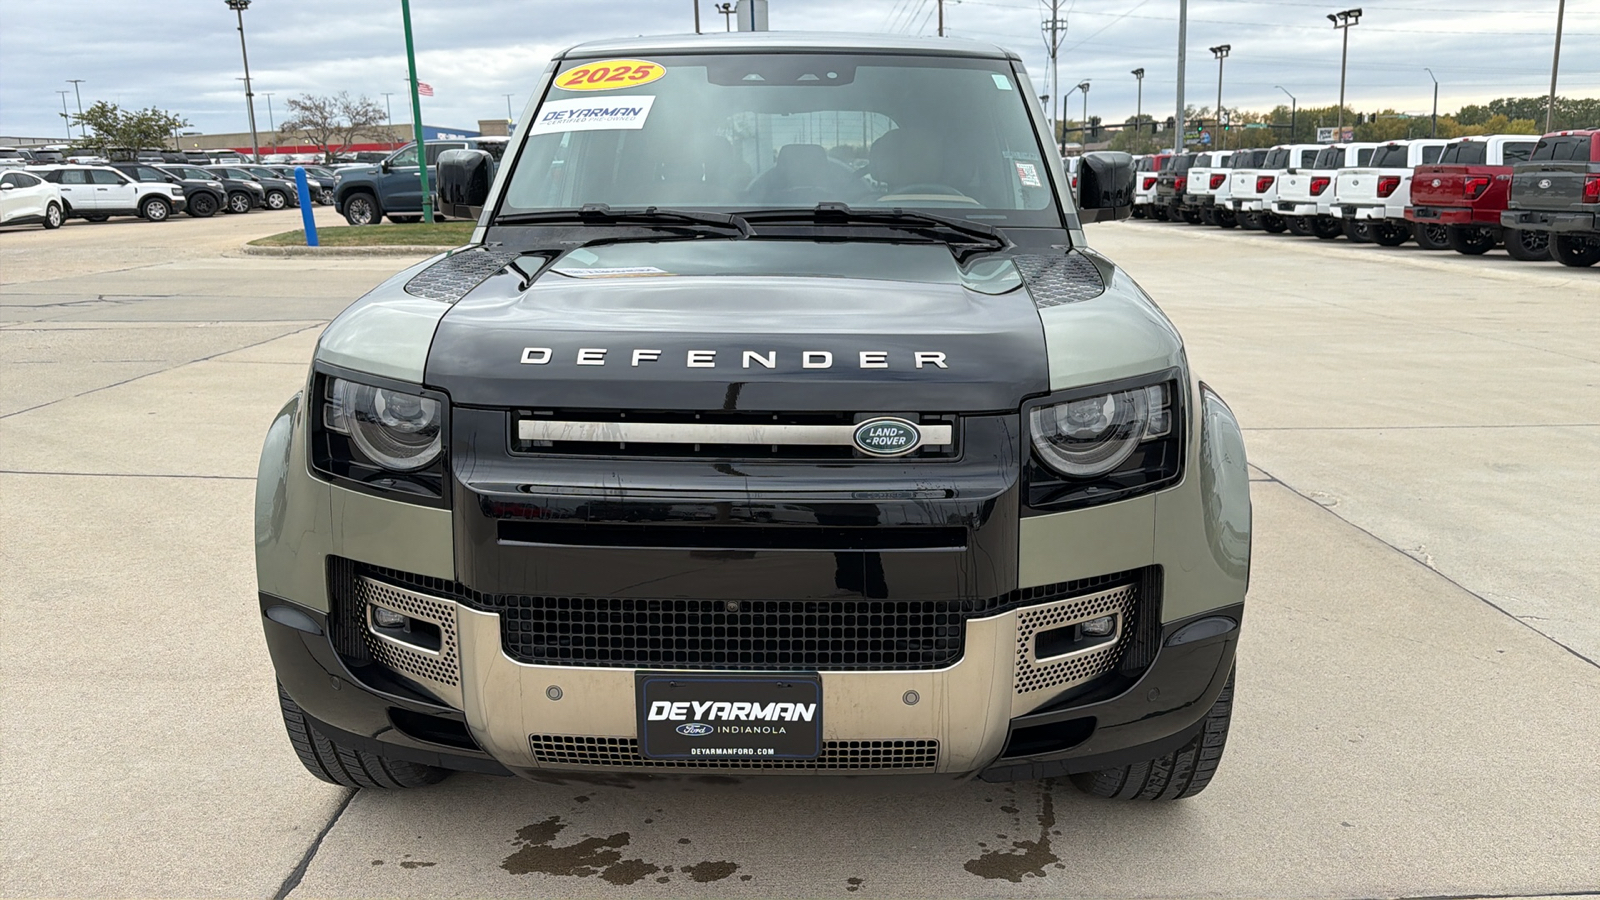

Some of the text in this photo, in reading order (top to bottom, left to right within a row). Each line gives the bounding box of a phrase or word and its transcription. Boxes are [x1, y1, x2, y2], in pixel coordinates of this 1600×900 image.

[564, 66, 655, 86] 2025
[543, 107, 643, 121] DEYARMAN
[546, 117, 587, 126] CERTIFIED
[520, 347, 949, 369] DEFENDER
[648, 701, 816, 722] DEYARMAN
[683, 724, 786, 734] Ford INDIANOLA
